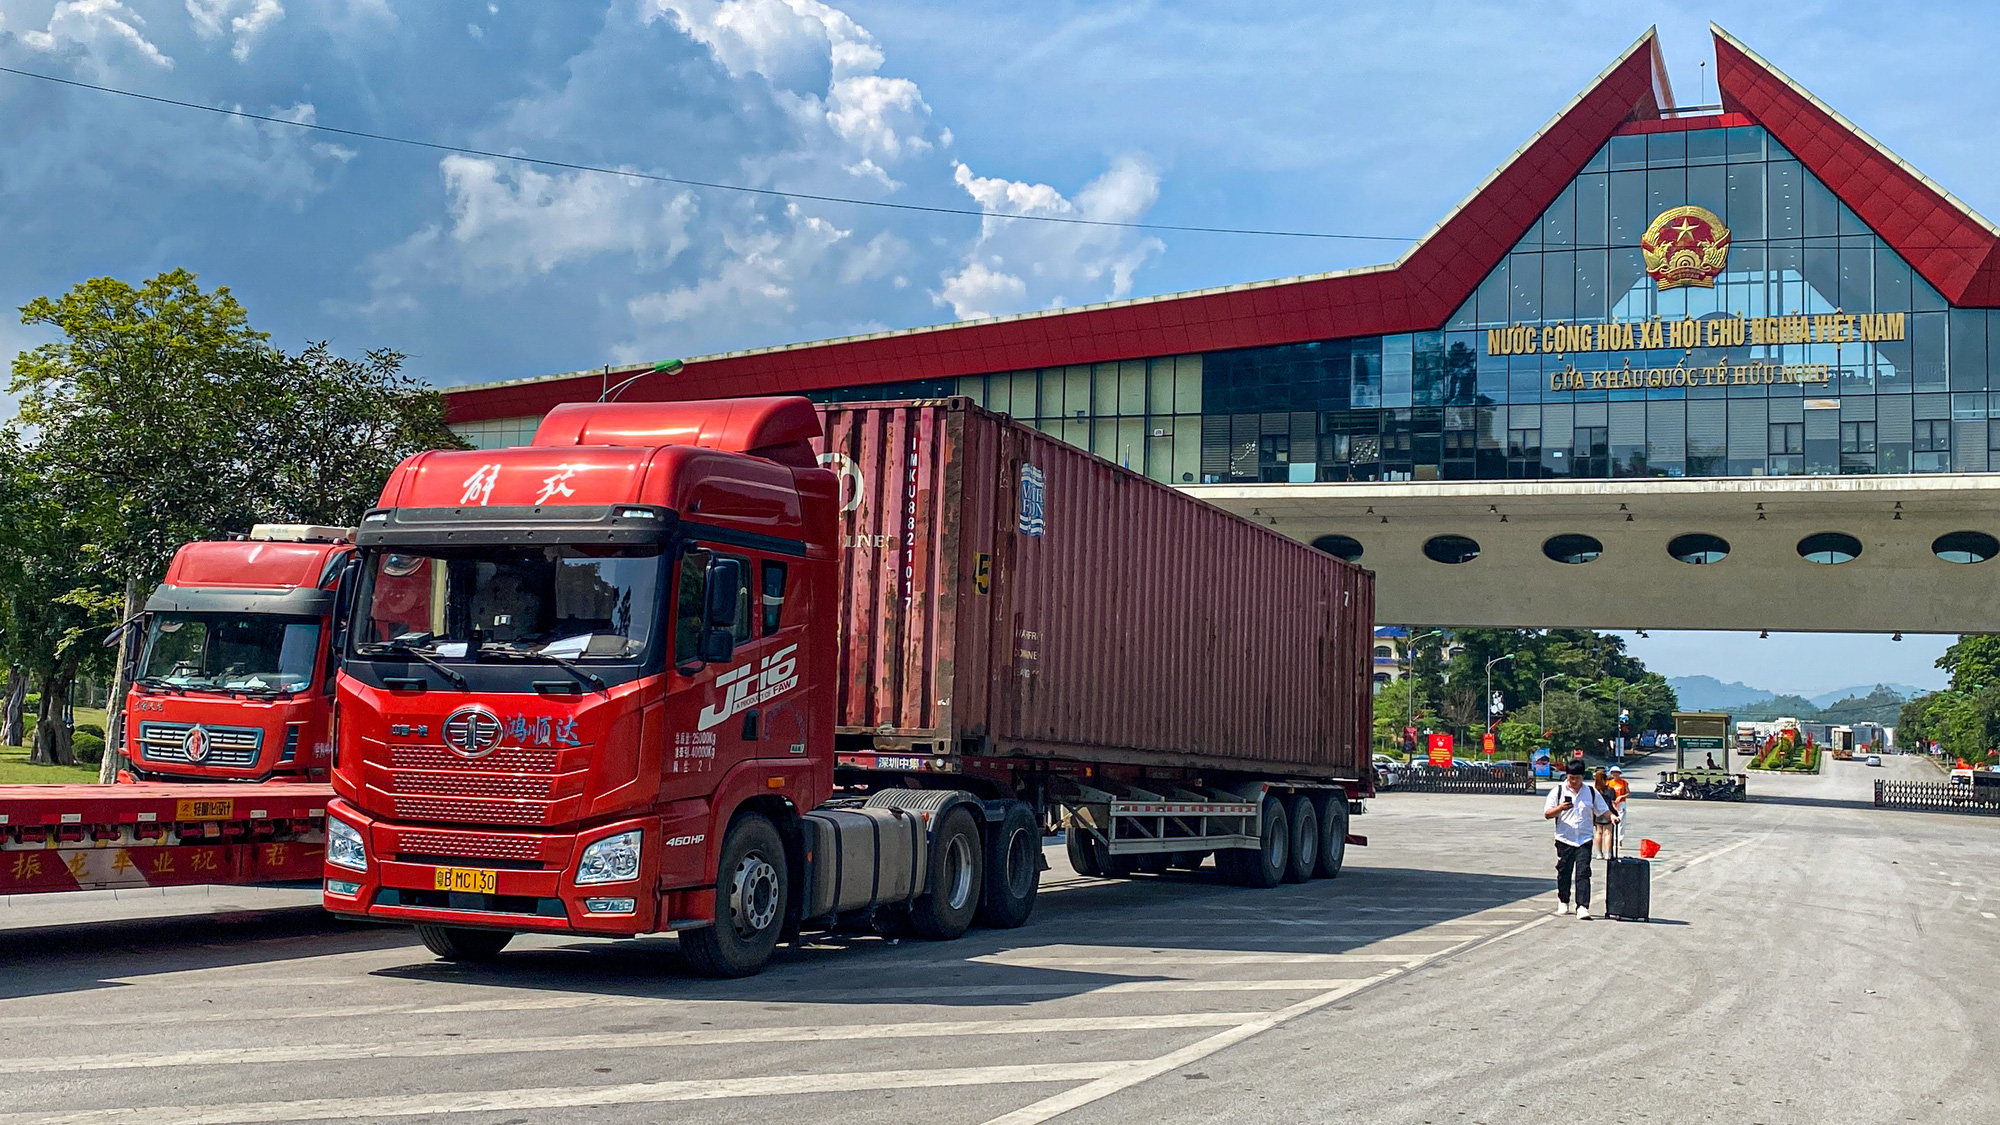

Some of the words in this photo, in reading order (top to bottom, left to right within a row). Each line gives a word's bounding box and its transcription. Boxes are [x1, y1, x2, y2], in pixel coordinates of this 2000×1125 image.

[1488, 321, 1537, 355] NƯỚC
[1542, 320, 1592, 360] CỘNG
[1598, 317, 1634, 350] HÒA
[1640, 314, 1663, 349] XÃ
[1670, 314, 1700, 356] HỘI
[1708, 311, 1745, 347] CHỦ
[1752, 309, 1811, 344] NGHĨA
[1814, 307, 1855, 350] VIỆT
[1860, 313, 1904, 341] NAM
[1551, 364, 1585, 391] CỬA
[1592, 357, 1643, 389] KHẨU
[1649, 357, 1699, 389] QUỐC
[1703, 355, 1728, 385] TẾ
[698, 643, 798, 732] JH6
[772, 679, 792, 695] FAW
[878, 756, 920, 769] 深圳中集
[194, 801, 231, 816] 轻量化设计
[666, 834, 705, 847] 460HP
